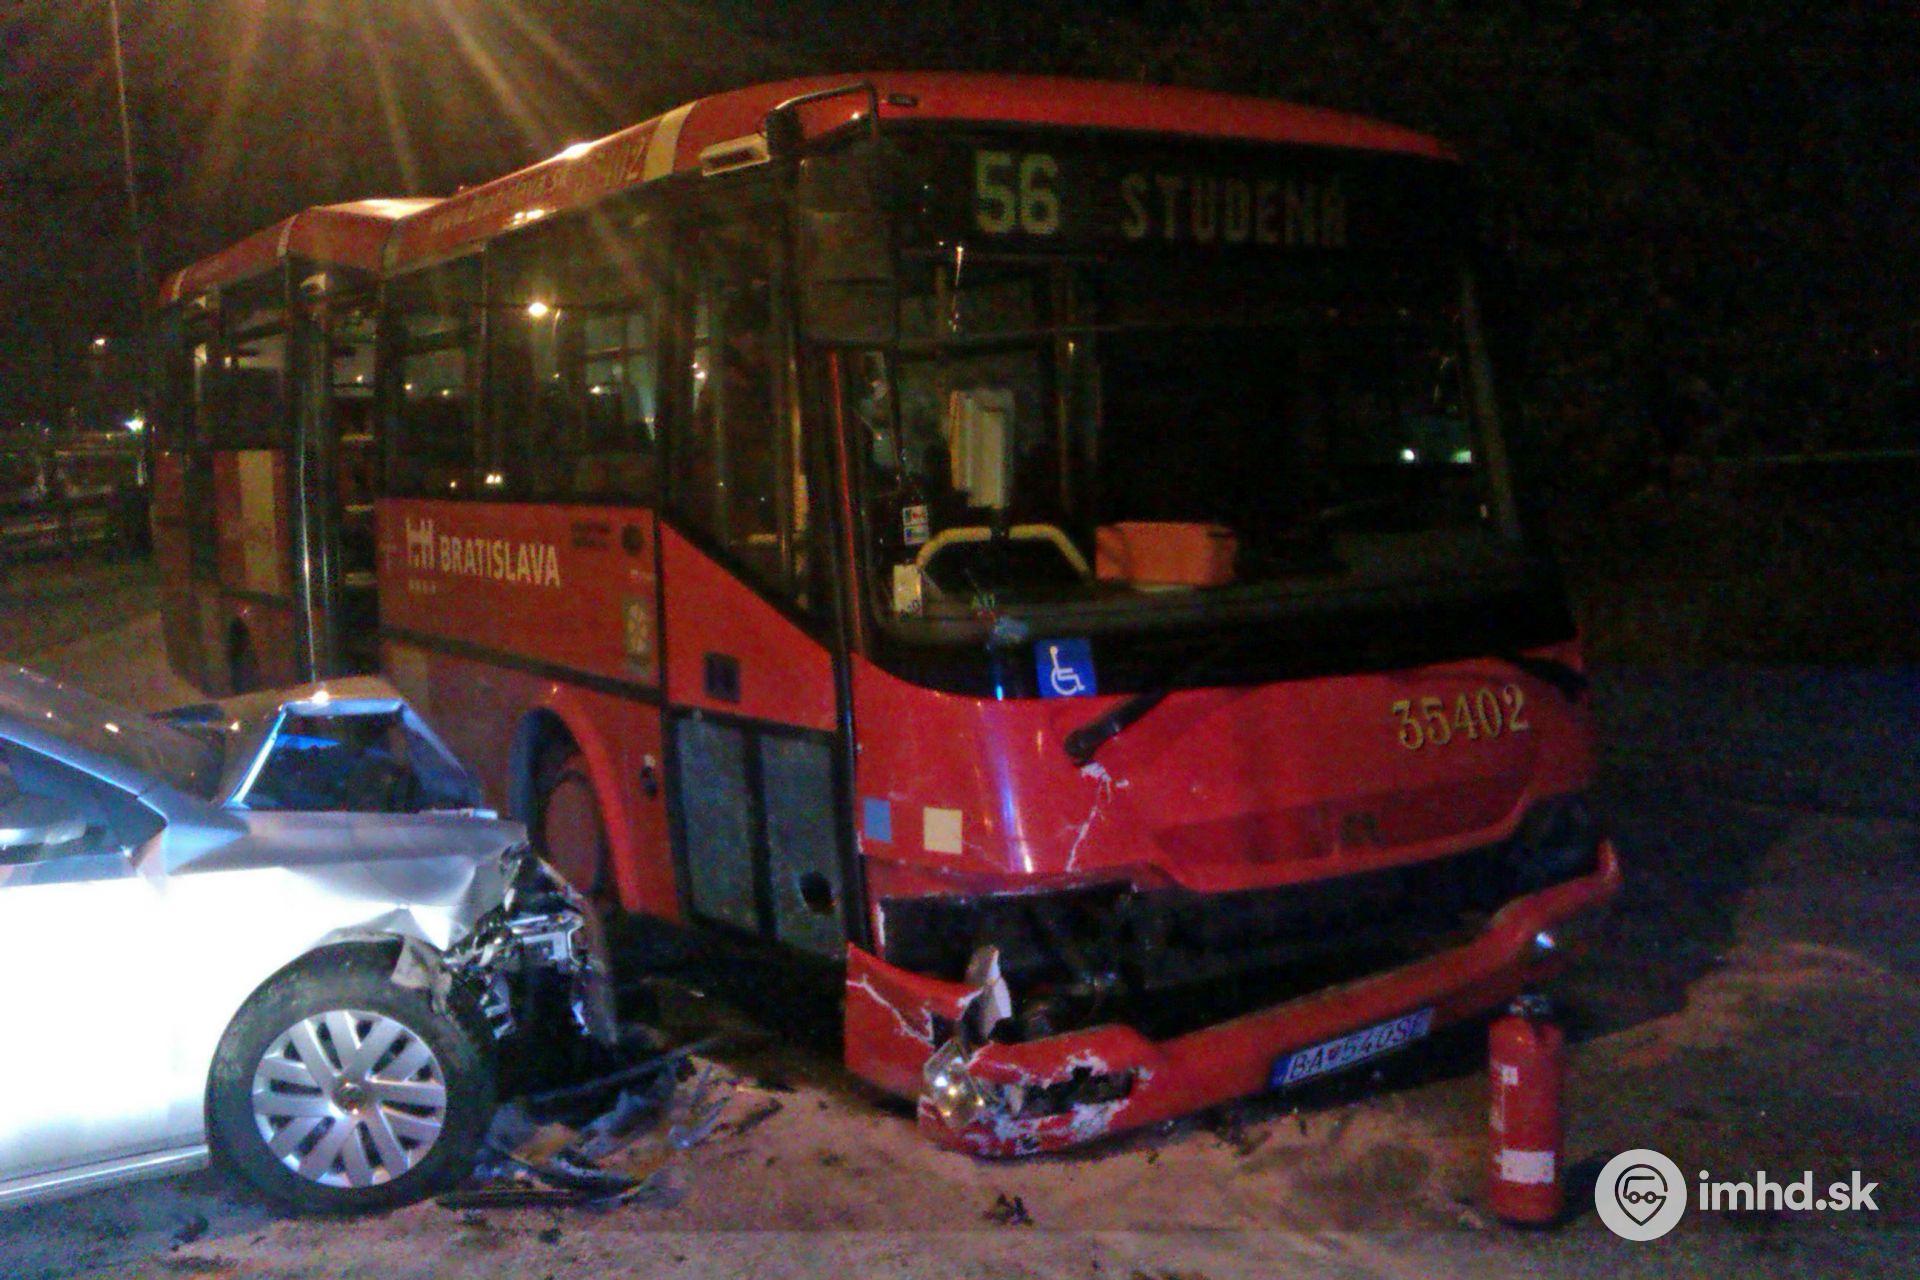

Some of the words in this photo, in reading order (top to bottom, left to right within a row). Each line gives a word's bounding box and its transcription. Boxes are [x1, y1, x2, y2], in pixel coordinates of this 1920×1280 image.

[975, 149, 1060, 235] 56
[439, 534, 561, 588] BRATISLAVA
[1392, 684, 1530, 749] 35402
